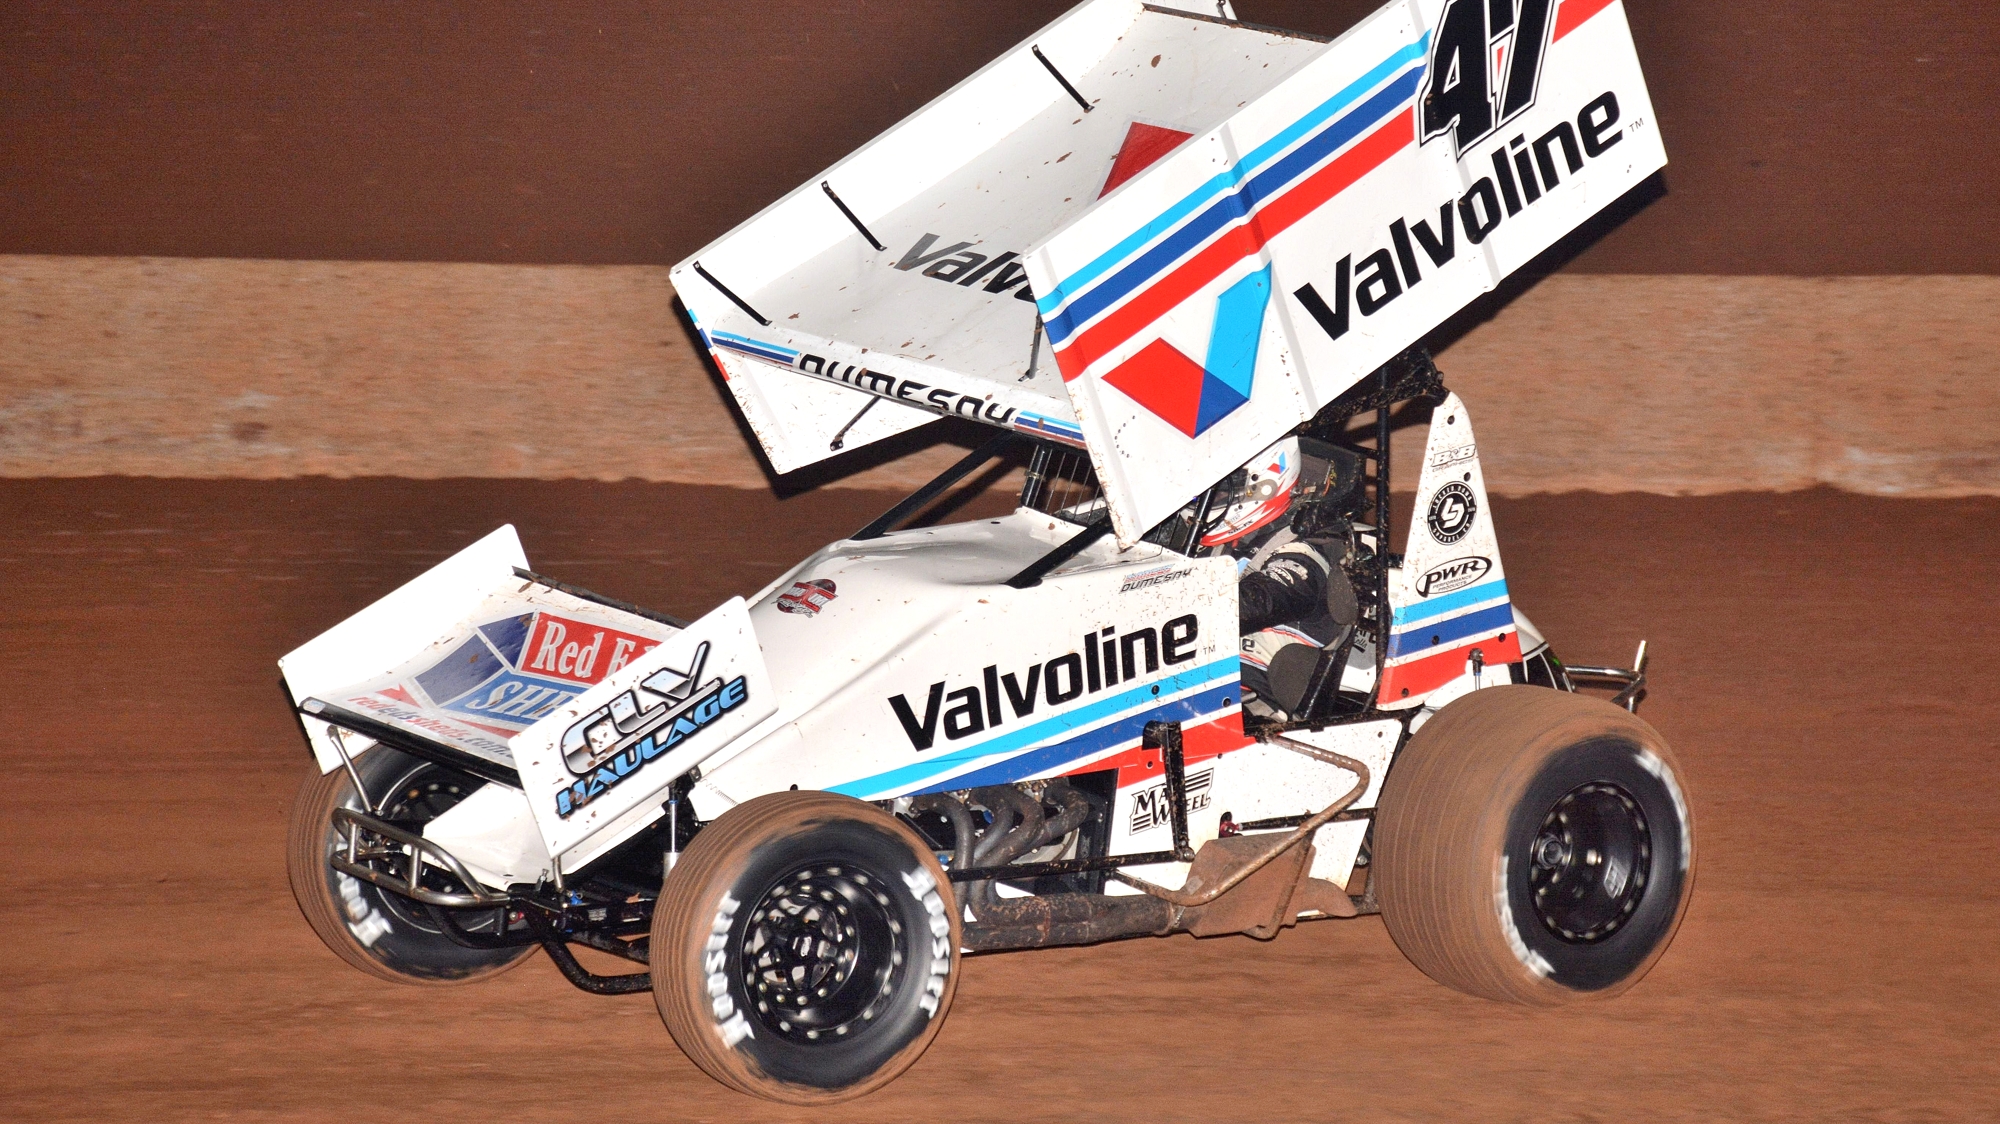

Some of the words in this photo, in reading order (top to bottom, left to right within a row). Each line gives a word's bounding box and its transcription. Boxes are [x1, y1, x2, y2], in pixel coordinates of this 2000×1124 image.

[1419, 0, 1555, 162] 47
[1293, 91, 1623, 341] Valvoline
[1118, 567, 1193, 594] DUMESNY
[1423, 559, 1480, 598] PWR
[530, 621, 605, 679] Red
[887, 613, 1199, 752] Valvoline
[556, 675, 749, 820] HAULAGE
